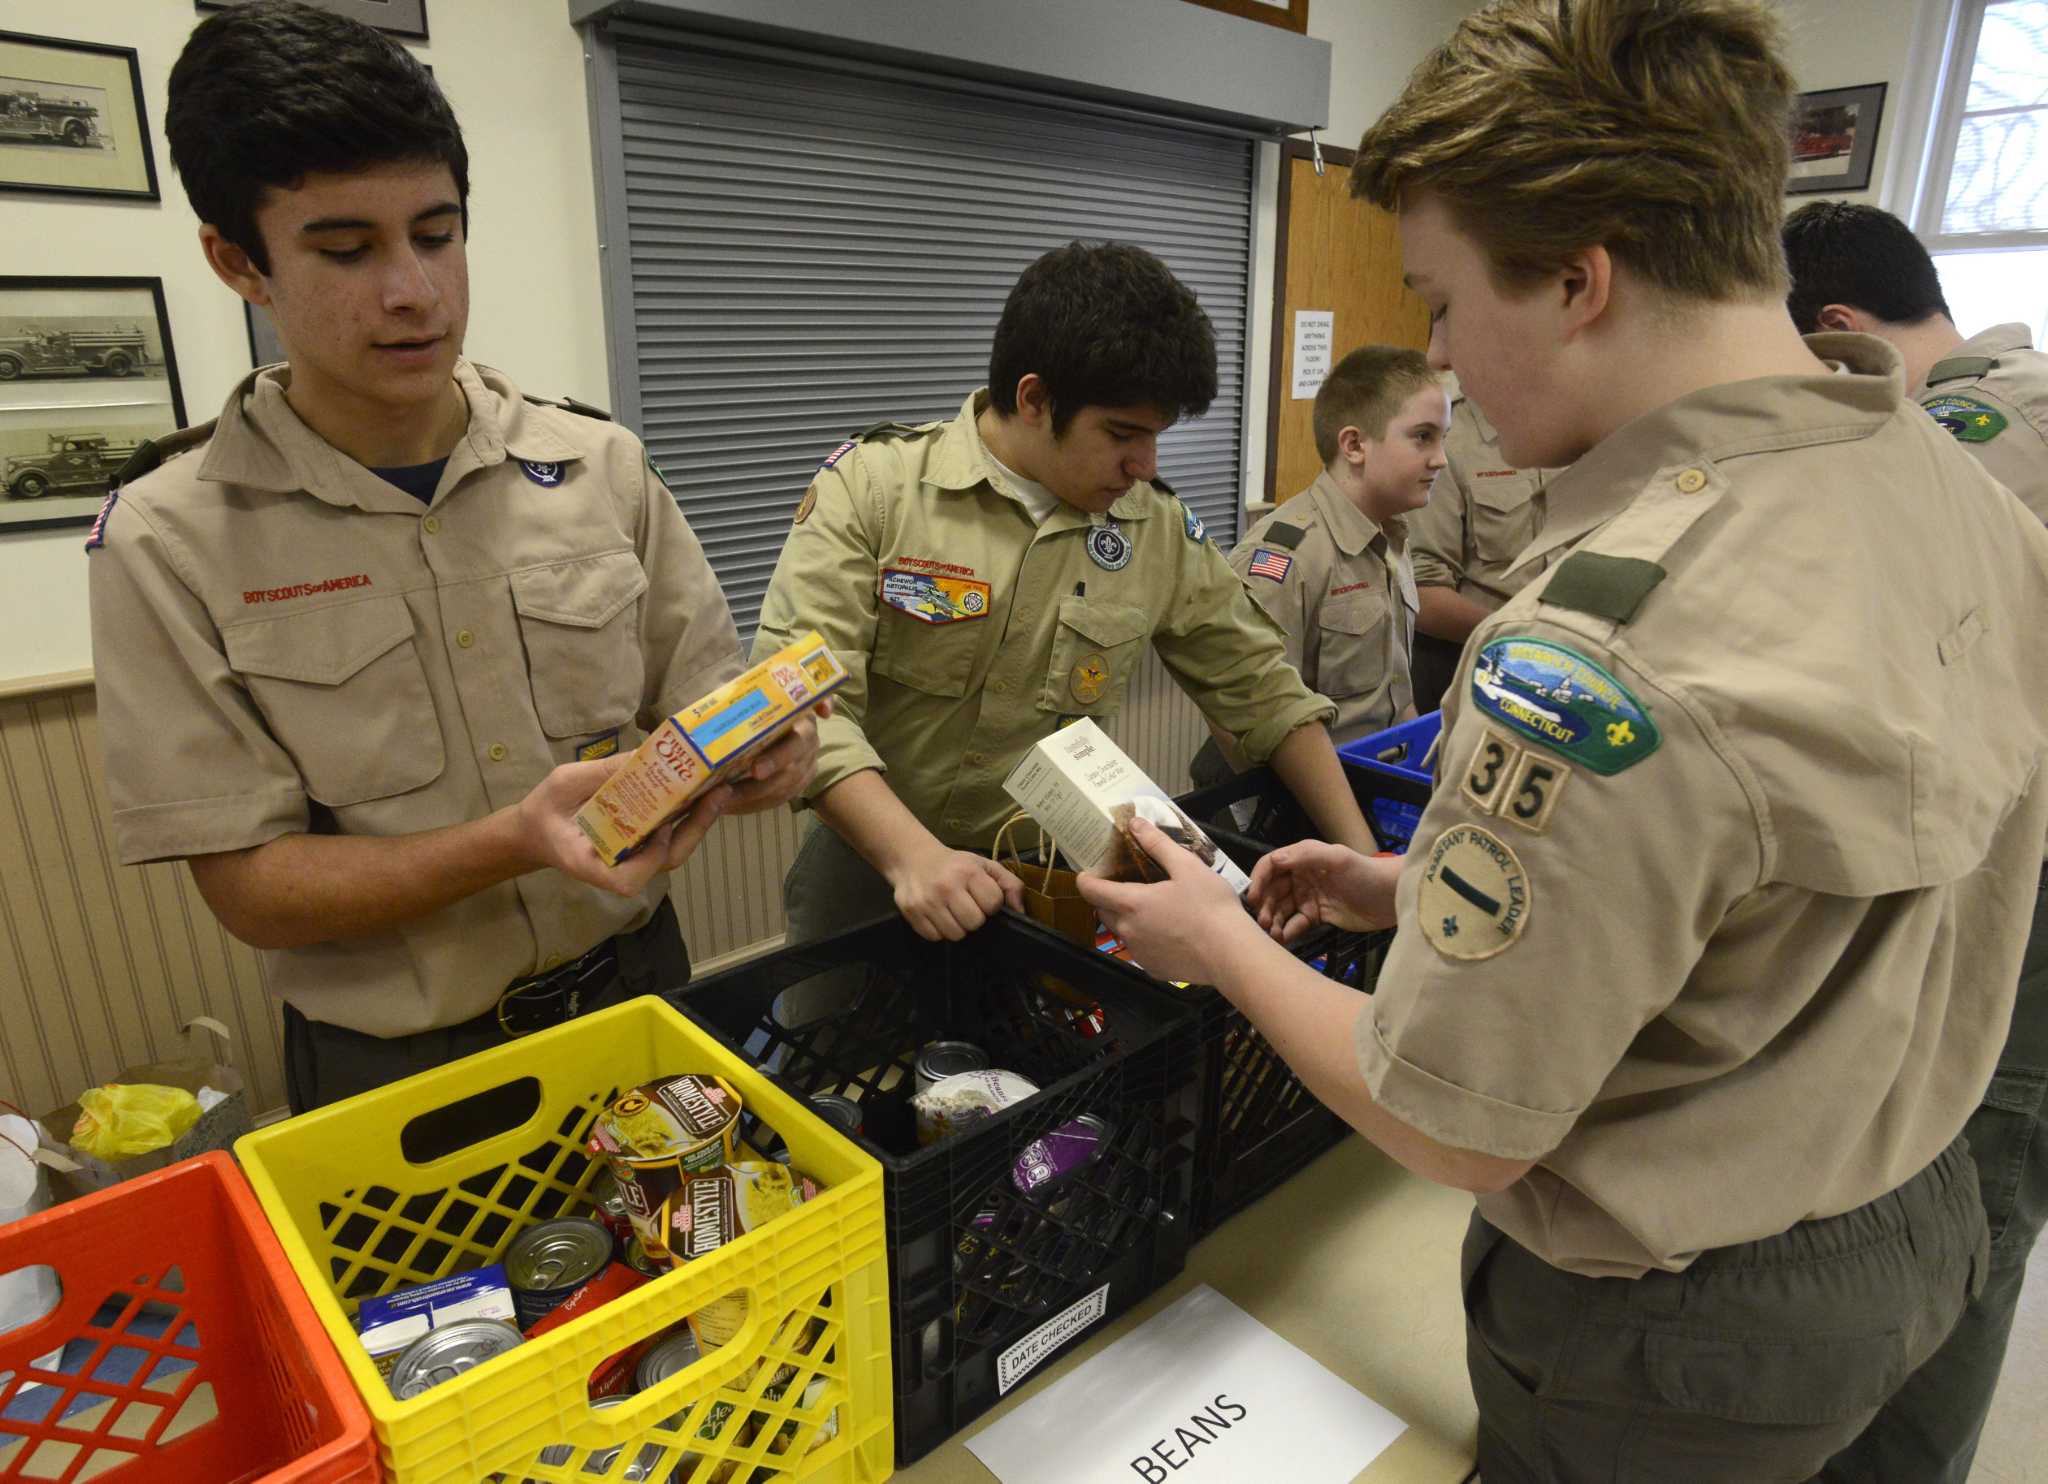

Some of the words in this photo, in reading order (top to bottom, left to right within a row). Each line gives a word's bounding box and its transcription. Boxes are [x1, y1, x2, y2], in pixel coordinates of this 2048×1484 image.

[242, 590, 268, 604] BOY
[267, 583, 313, 602] SCOUTS
[322, 574, 373, 592] AMERICA
[1500, 698, 1576, 744] CONNECTICUT
[1469, 831, 1512, 873] PATROL
[1497, 875, 1525, 936] LEADER
[668, 1078, 725, 1130] HOMESTYLE
[692, 1180, 721, 1255] HOMESTYLE
[1011, 1342, 1040, 1370] DATE
[1041, 1304, 1093, 1346] CHECKED
[1129, 1393, 1248, 1484] BEANS
